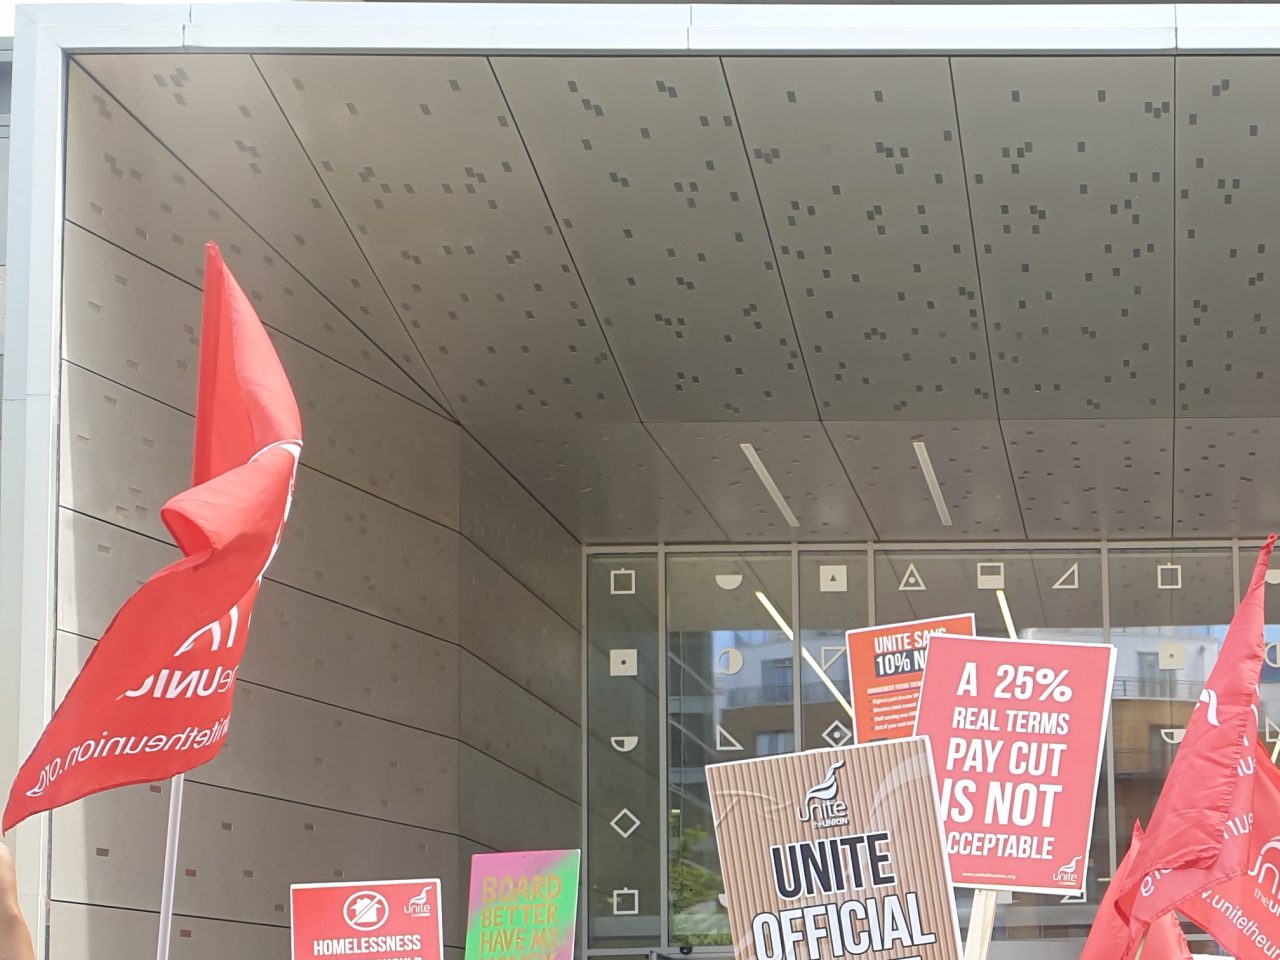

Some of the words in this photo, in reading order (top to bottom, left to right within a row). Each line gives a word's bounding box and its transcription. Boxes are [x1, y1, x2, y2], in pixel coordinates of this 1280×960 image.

[874, 632, 912, 653] UNITE
[876, 652, 911, 675] 10%
[956, 662, 978, 697] A
[993, 664, 1073, 702] 25%
[952, 707, 1001, 731] REAL
[1005, 709, 1069, 735] TERMS
[946, 737, 1004, 774] PAY
[1008, 741, 1067, 777] CUT
[942, 778, 977, 823] IS
[984, 781, 1063, 828] NOT
[948, 831, 1055, 860] CCEPTABLE
[771, 830, 897, 900] UNITE
[482, 876, 562, 902] BOARD
[482, 901, 558, 926] BETTER
[313, 934, 421, 956] HOMELESSNESS
[480, 928, 525, 953] HAVE
[531, 926, 559, 950] MY
